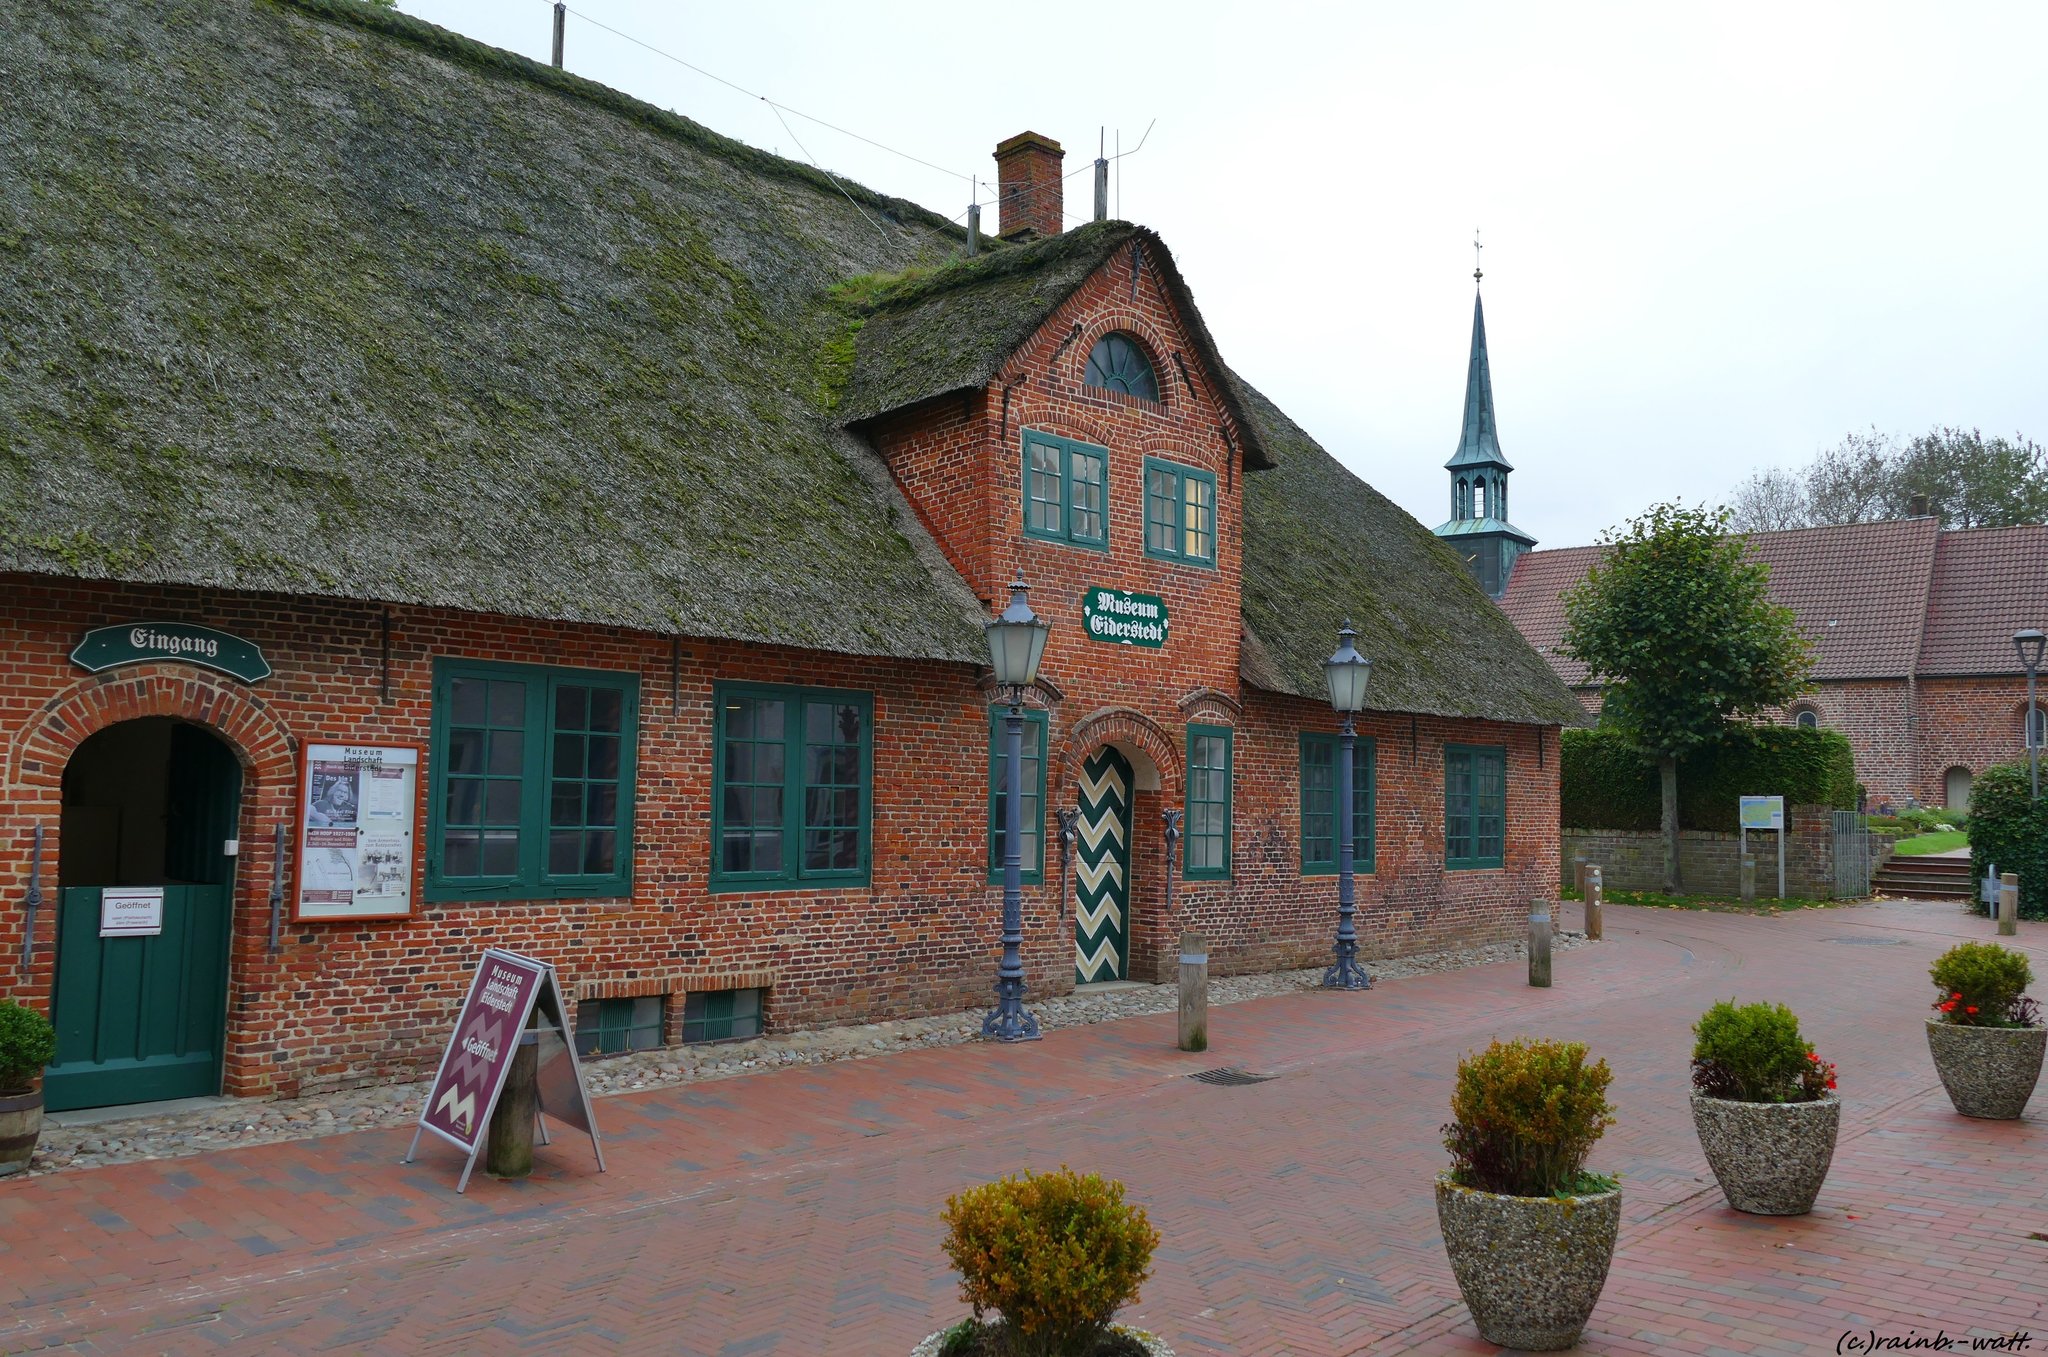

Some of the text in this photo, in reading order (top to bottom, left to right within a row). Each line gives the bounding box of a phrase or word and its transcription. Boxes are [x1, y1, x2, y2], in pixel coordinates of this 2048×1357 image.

[1097, 591, 1159, 619] Museum
[1090, 614, 1163, 642] Eiderstedt
[130, 627, 218, 658] Eingang
[343, 755, 383, 764] Landschaft
[344, 747, 383, 756] Museum
[343, 763, 382, 772] Eiderstedt
[491, 965, 523, 985] Museum
[486, 978, 519, 999] Landschaft
[480, 992, 513, 1013] Eiderstedt
[467, 1038, 498, 1063] Geöffnet
